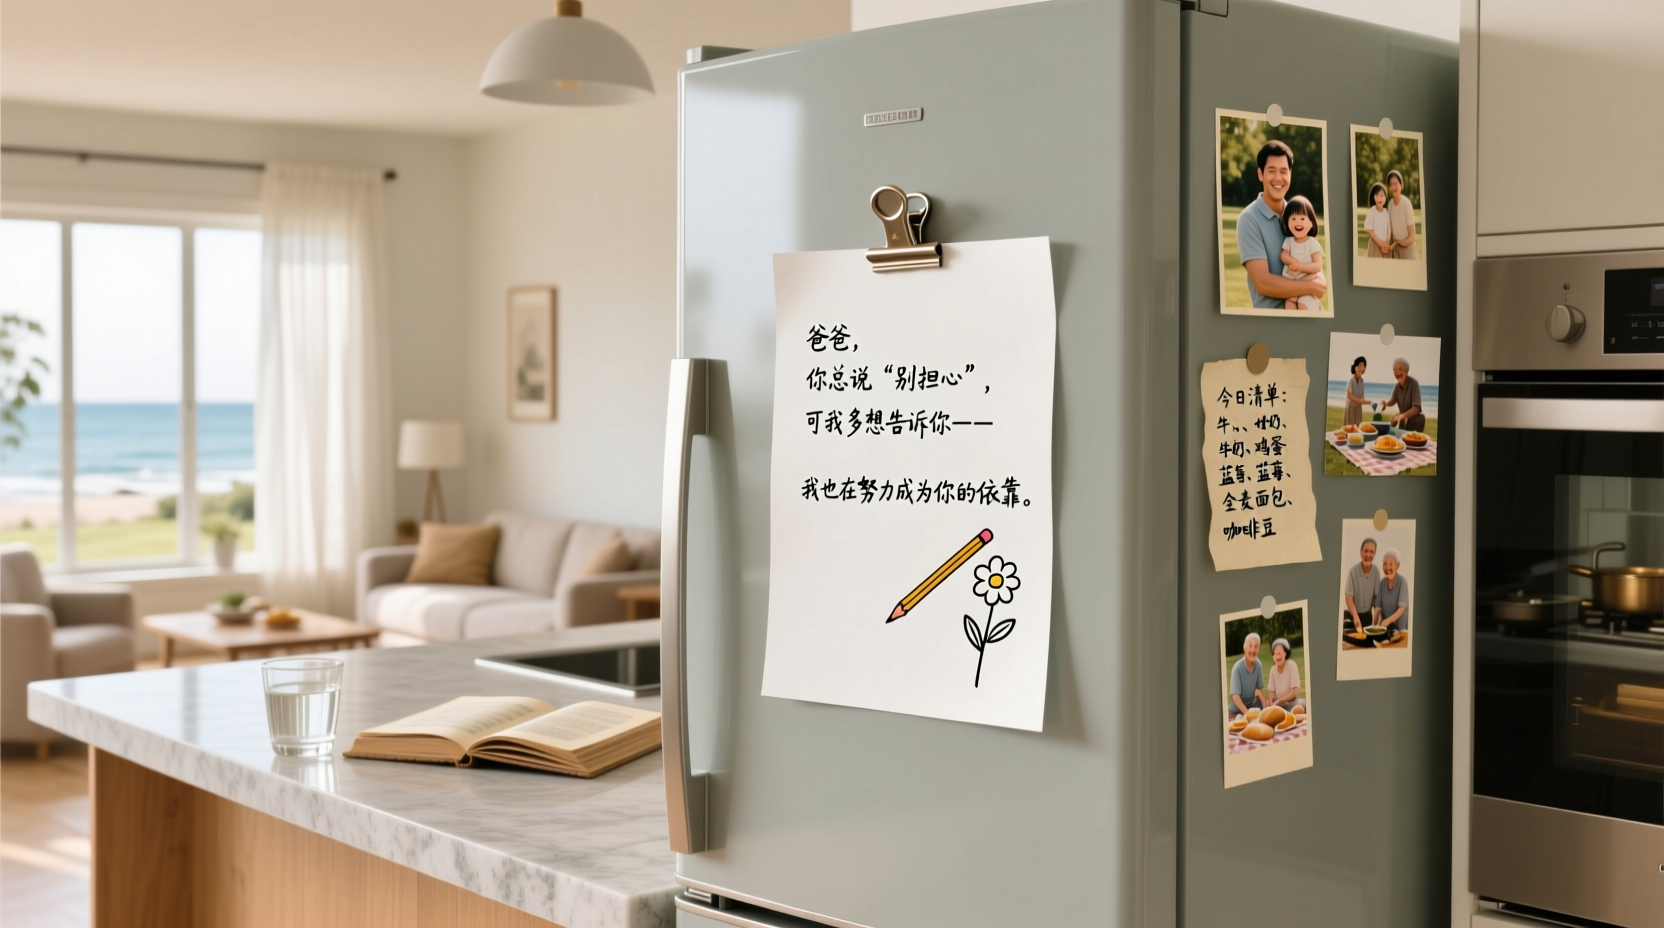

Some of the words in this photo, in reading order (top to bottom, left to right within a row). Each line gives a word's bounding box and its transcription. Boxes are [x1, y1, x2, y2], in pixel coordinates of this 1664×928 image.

[807, 324, 858, 352] 爸爸，
[806, 364, 990, 394] 你总说“别担心”，
[1217, 382, 1286, 408] 今日清单：
[806, 407, 993, 439] 可我多想告诉你——
[801, 476, 1030, 508] 我也在努力成为你的依靠。
[1223, 486, 1292, 512] 全麦面包、
